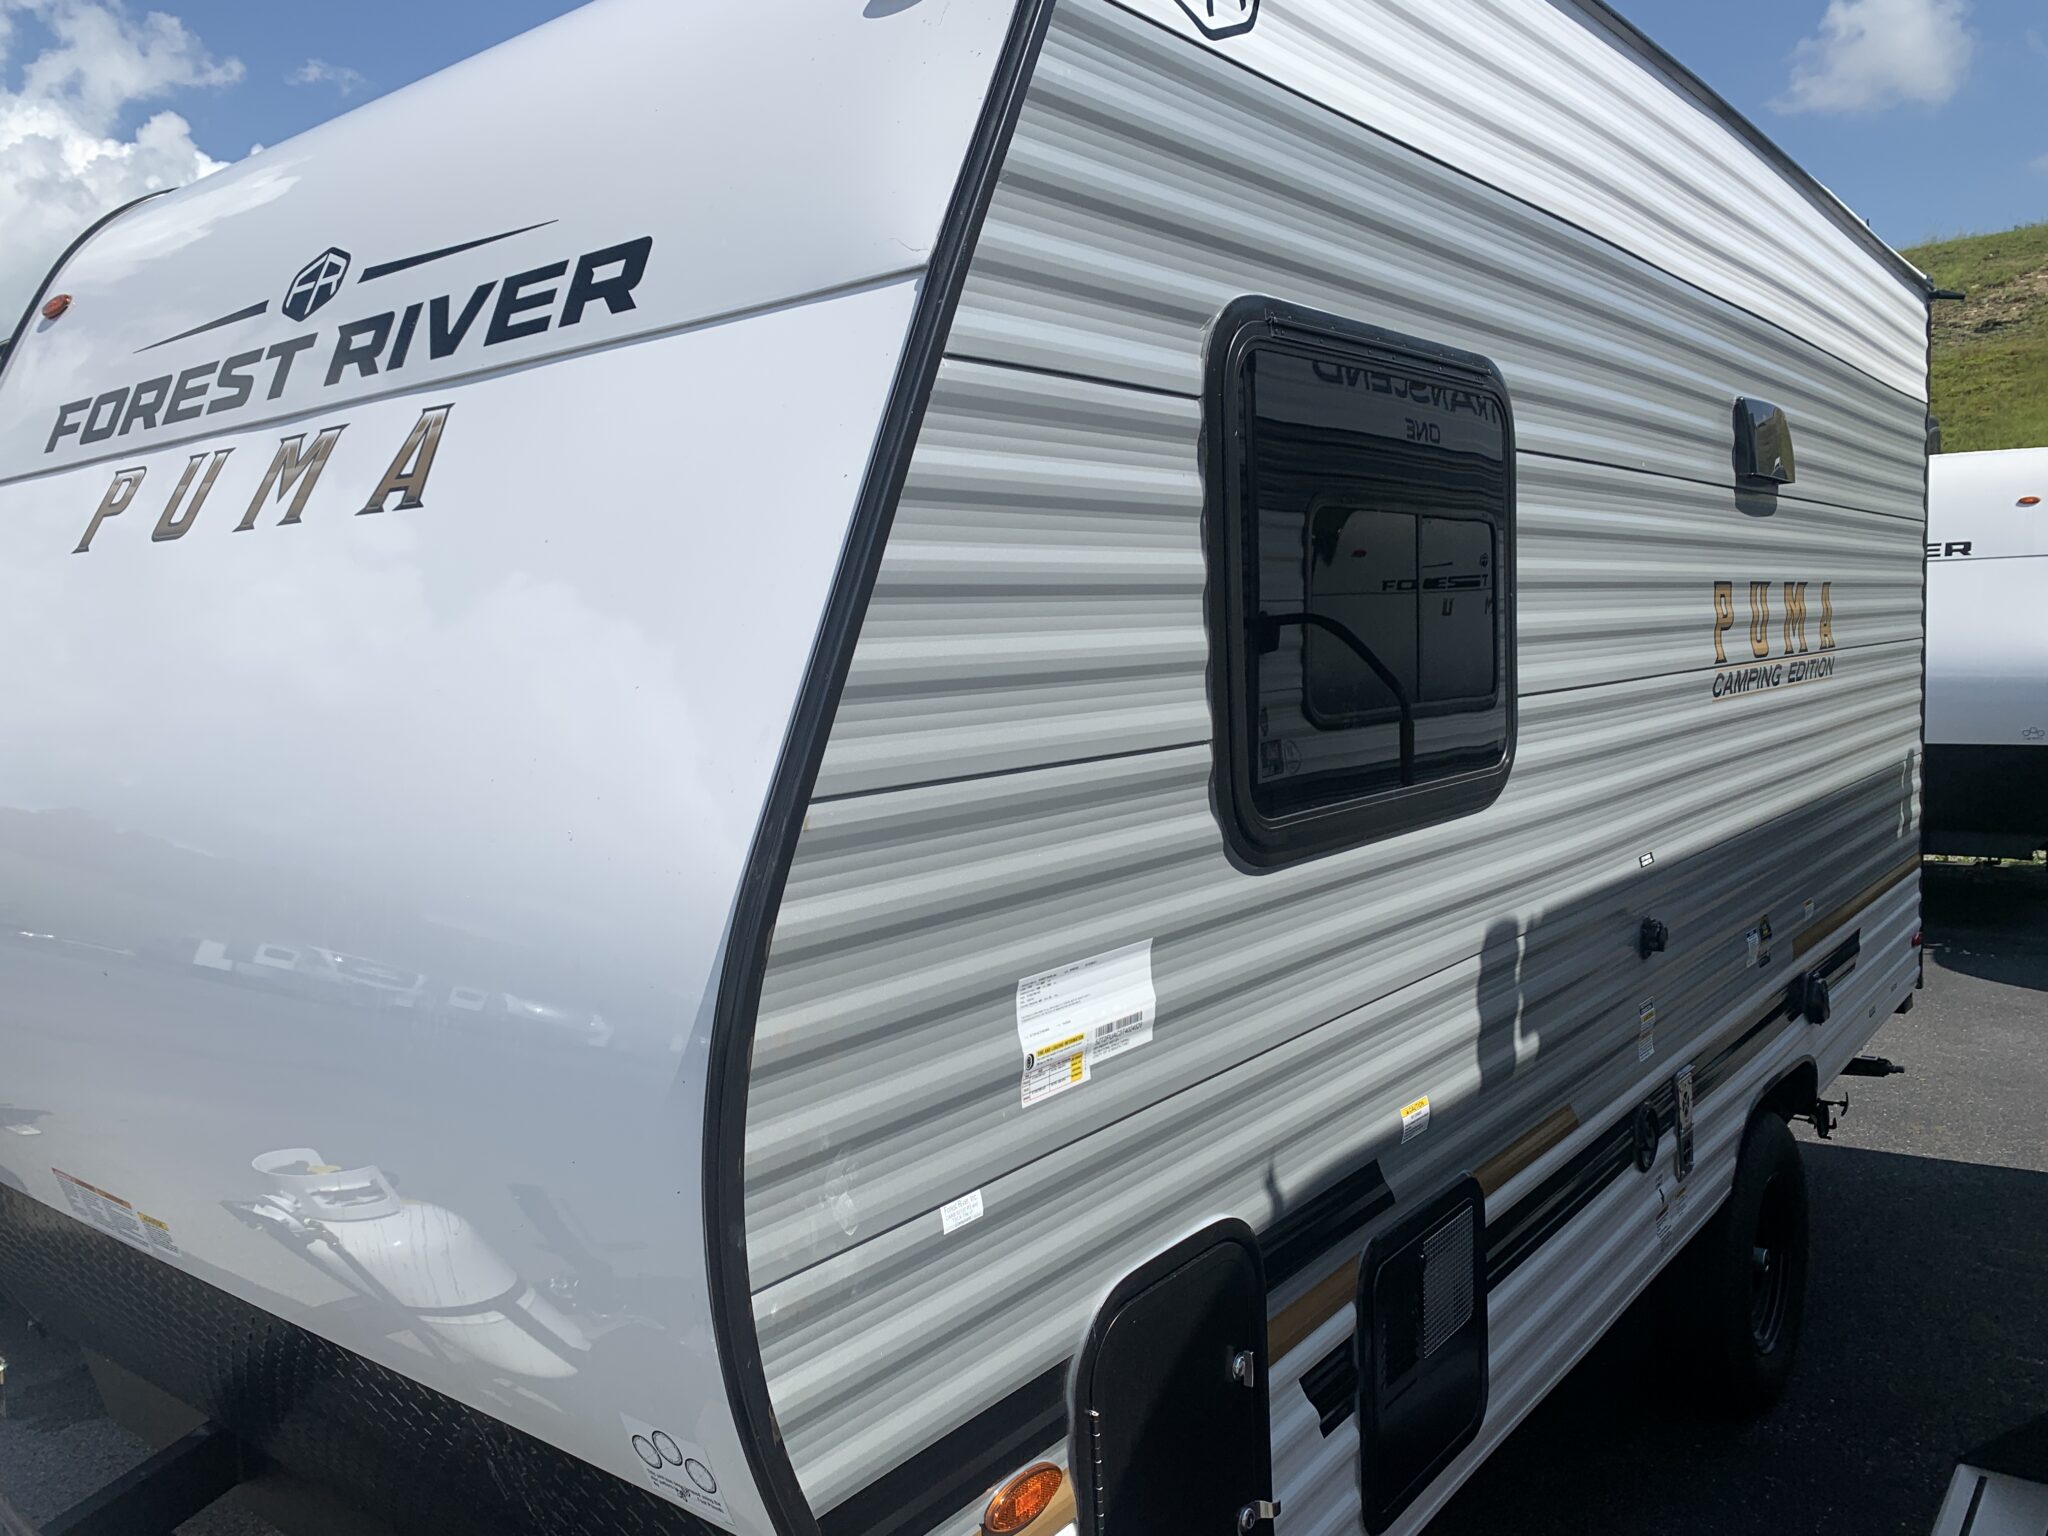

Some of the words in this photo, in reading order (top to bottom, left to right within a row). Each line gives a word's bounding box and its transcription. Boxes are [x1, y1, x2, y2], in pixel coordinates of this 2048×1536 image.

[44, 333, 317, 454] FOREST
[323, 235, 653, 387] RIVER
[71, 402, 456, 555] PUMA
[1712, 663, 1783, 698] CAMPING
[1787, 656, 1836, 684] EDITION
[1713, 580, 1836, 665] PUMA
